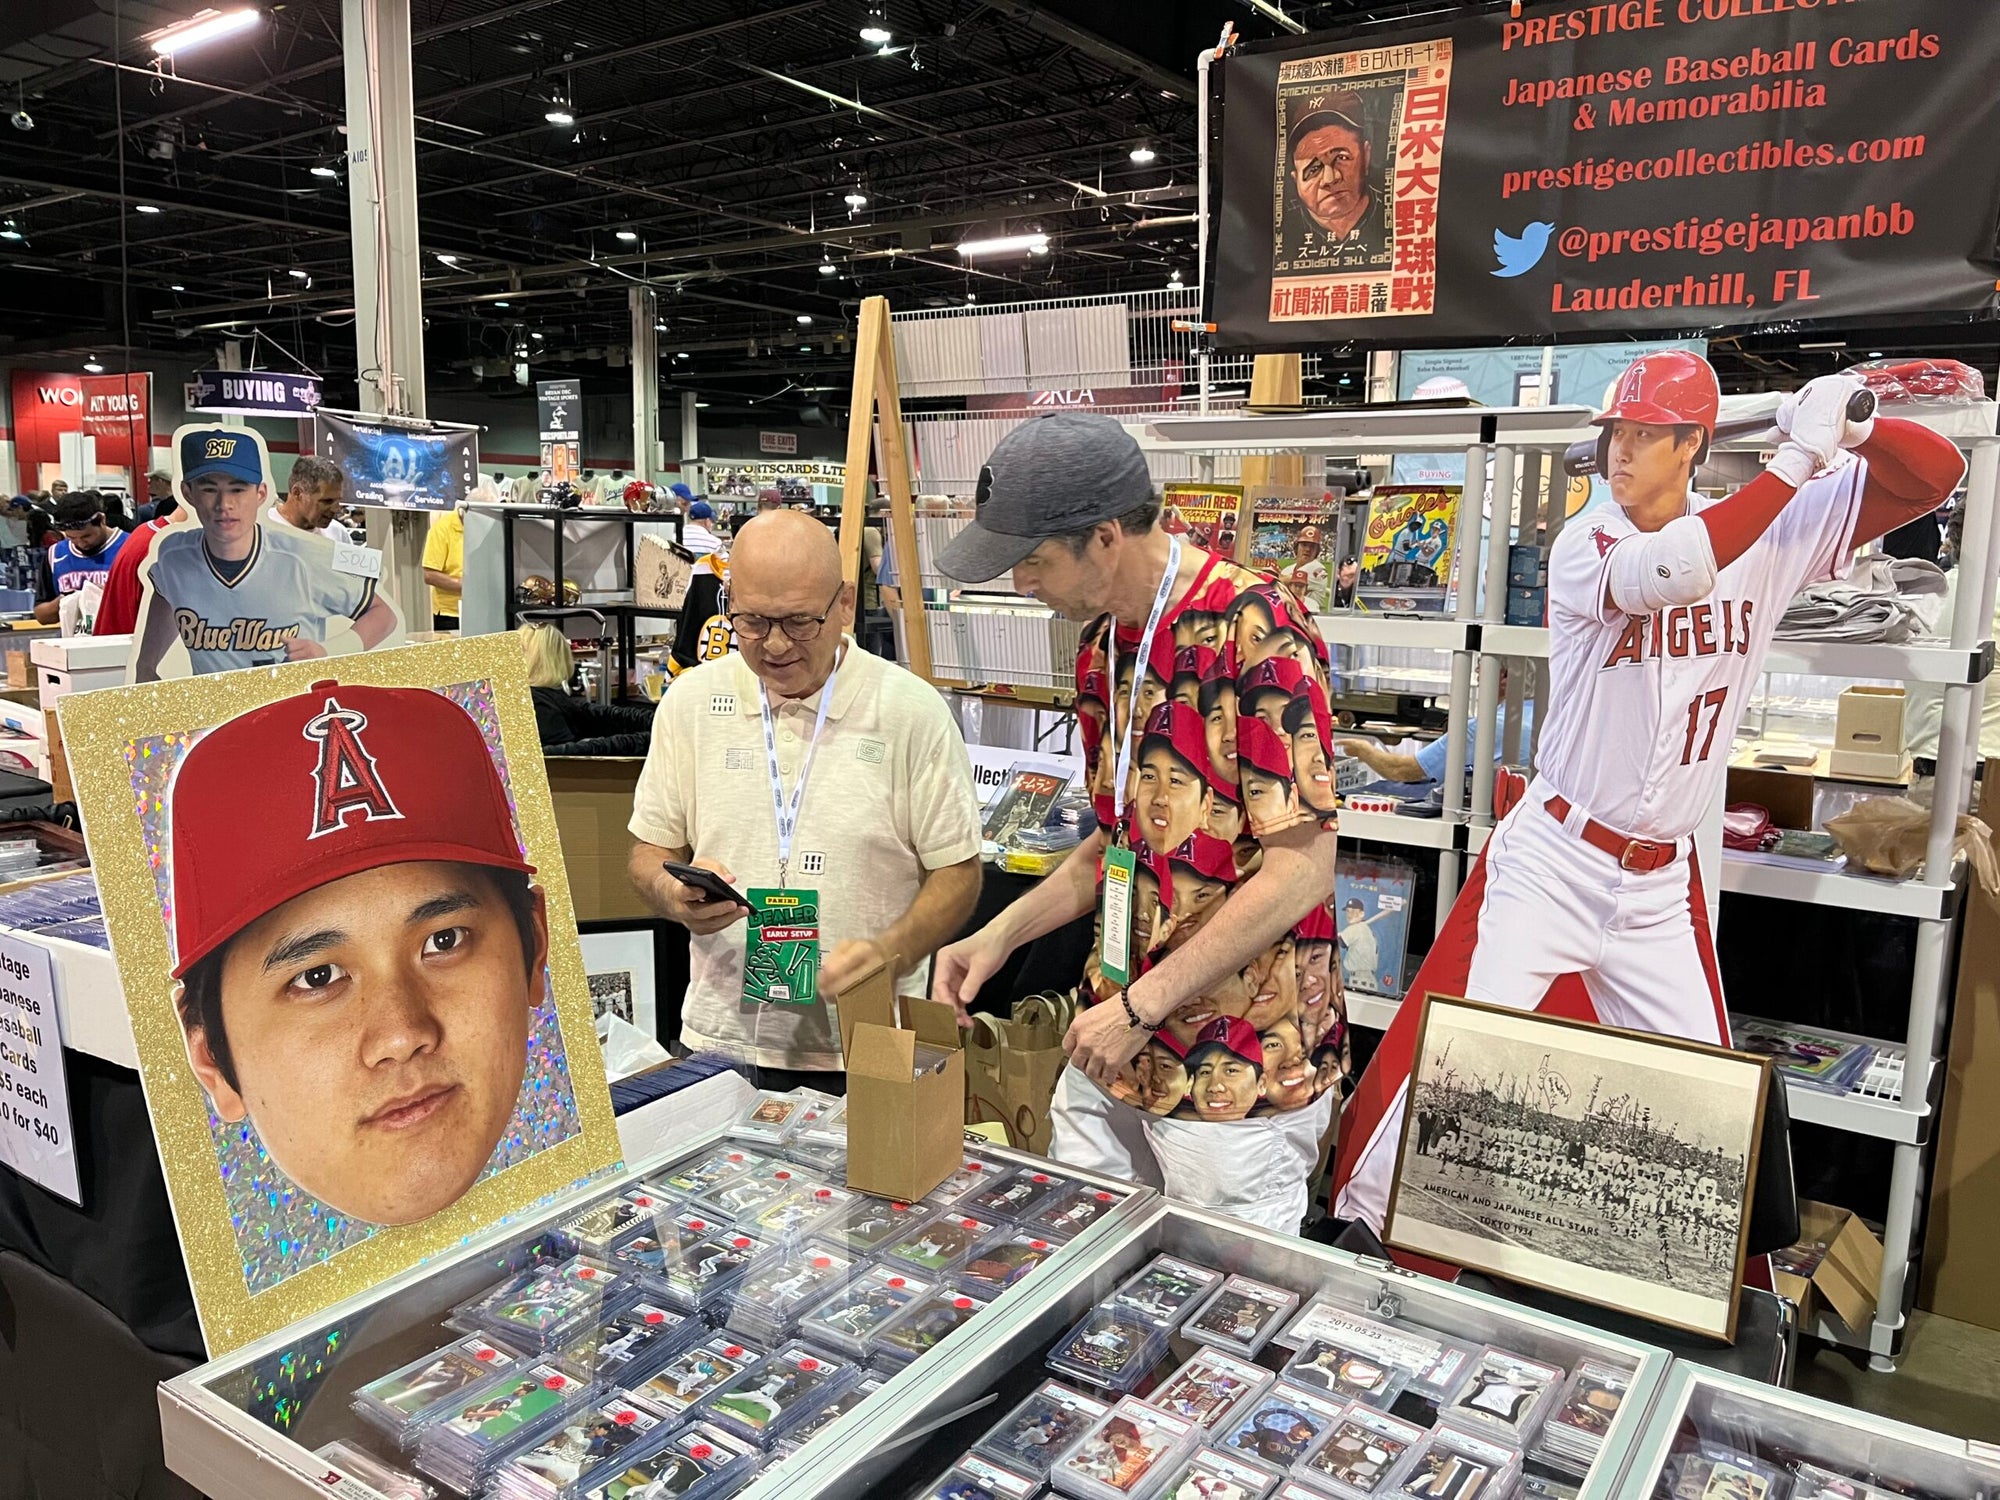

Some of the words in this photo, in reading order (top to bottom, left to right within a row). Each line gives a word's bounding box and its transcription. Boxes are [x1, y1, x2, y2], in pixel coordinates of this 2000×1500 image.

[1502, 0, 1664, 51] PRESTIGE
[1503, 66, 1652, 106] Japanese
[1665, 40, 1817, 86] Baseball
[1829, 28, 1941, 68] Cards
[1573, 103, 1596, 131] &
[1608, 79, 1827, 127] Memorabilia
[1502, 134, 1926, 198] prestigecollectibles.com
[1558, 202, 1915, 262] @prestigejapanbb
[1551, 272, 1756, 313] Lauderhill,
[1773, 269, 1820, 302] FL
[222, 379, 286, 403] BUYING
[205, 438, 236, 459] BW
[762, 433, 776, 445] FIRE
[777, 434, 796, 447] EXITS
[340, 551, 379, 574] SOLD
[707, 627, 730, 660] B
[1598, 599, 1753, 670] ANGELS
[1680, 686, 1729, 766] 17
[302, 697, 405, 841] A
[748, 905, 818, 928] DEALER
[790, 930, 814, 938] SETUP
[0, 952, 30, 980] tage
[0, 1042, 38, 1074] Cards
[16, 1081, 48, 1110] each
[13, 1107, 30, 1132] for
[34, 1117, 58, 1145] $40
[1423, 1183, 1470, 1201] AMERICAN
[1472, 1196, 1492, 1208] AND
[1493, 1202, 1542, 1222] JAPANESE
[1544, 1215, 1565, 1227] ALL
[1568, 1221, 1599, 1237] STARS
[1479, 1215, 1511, 1231] TOKYO
[1513, 1224, 1533, 1237] 1934
[1328, 1316, 1383, 1341] 2013.05.23
